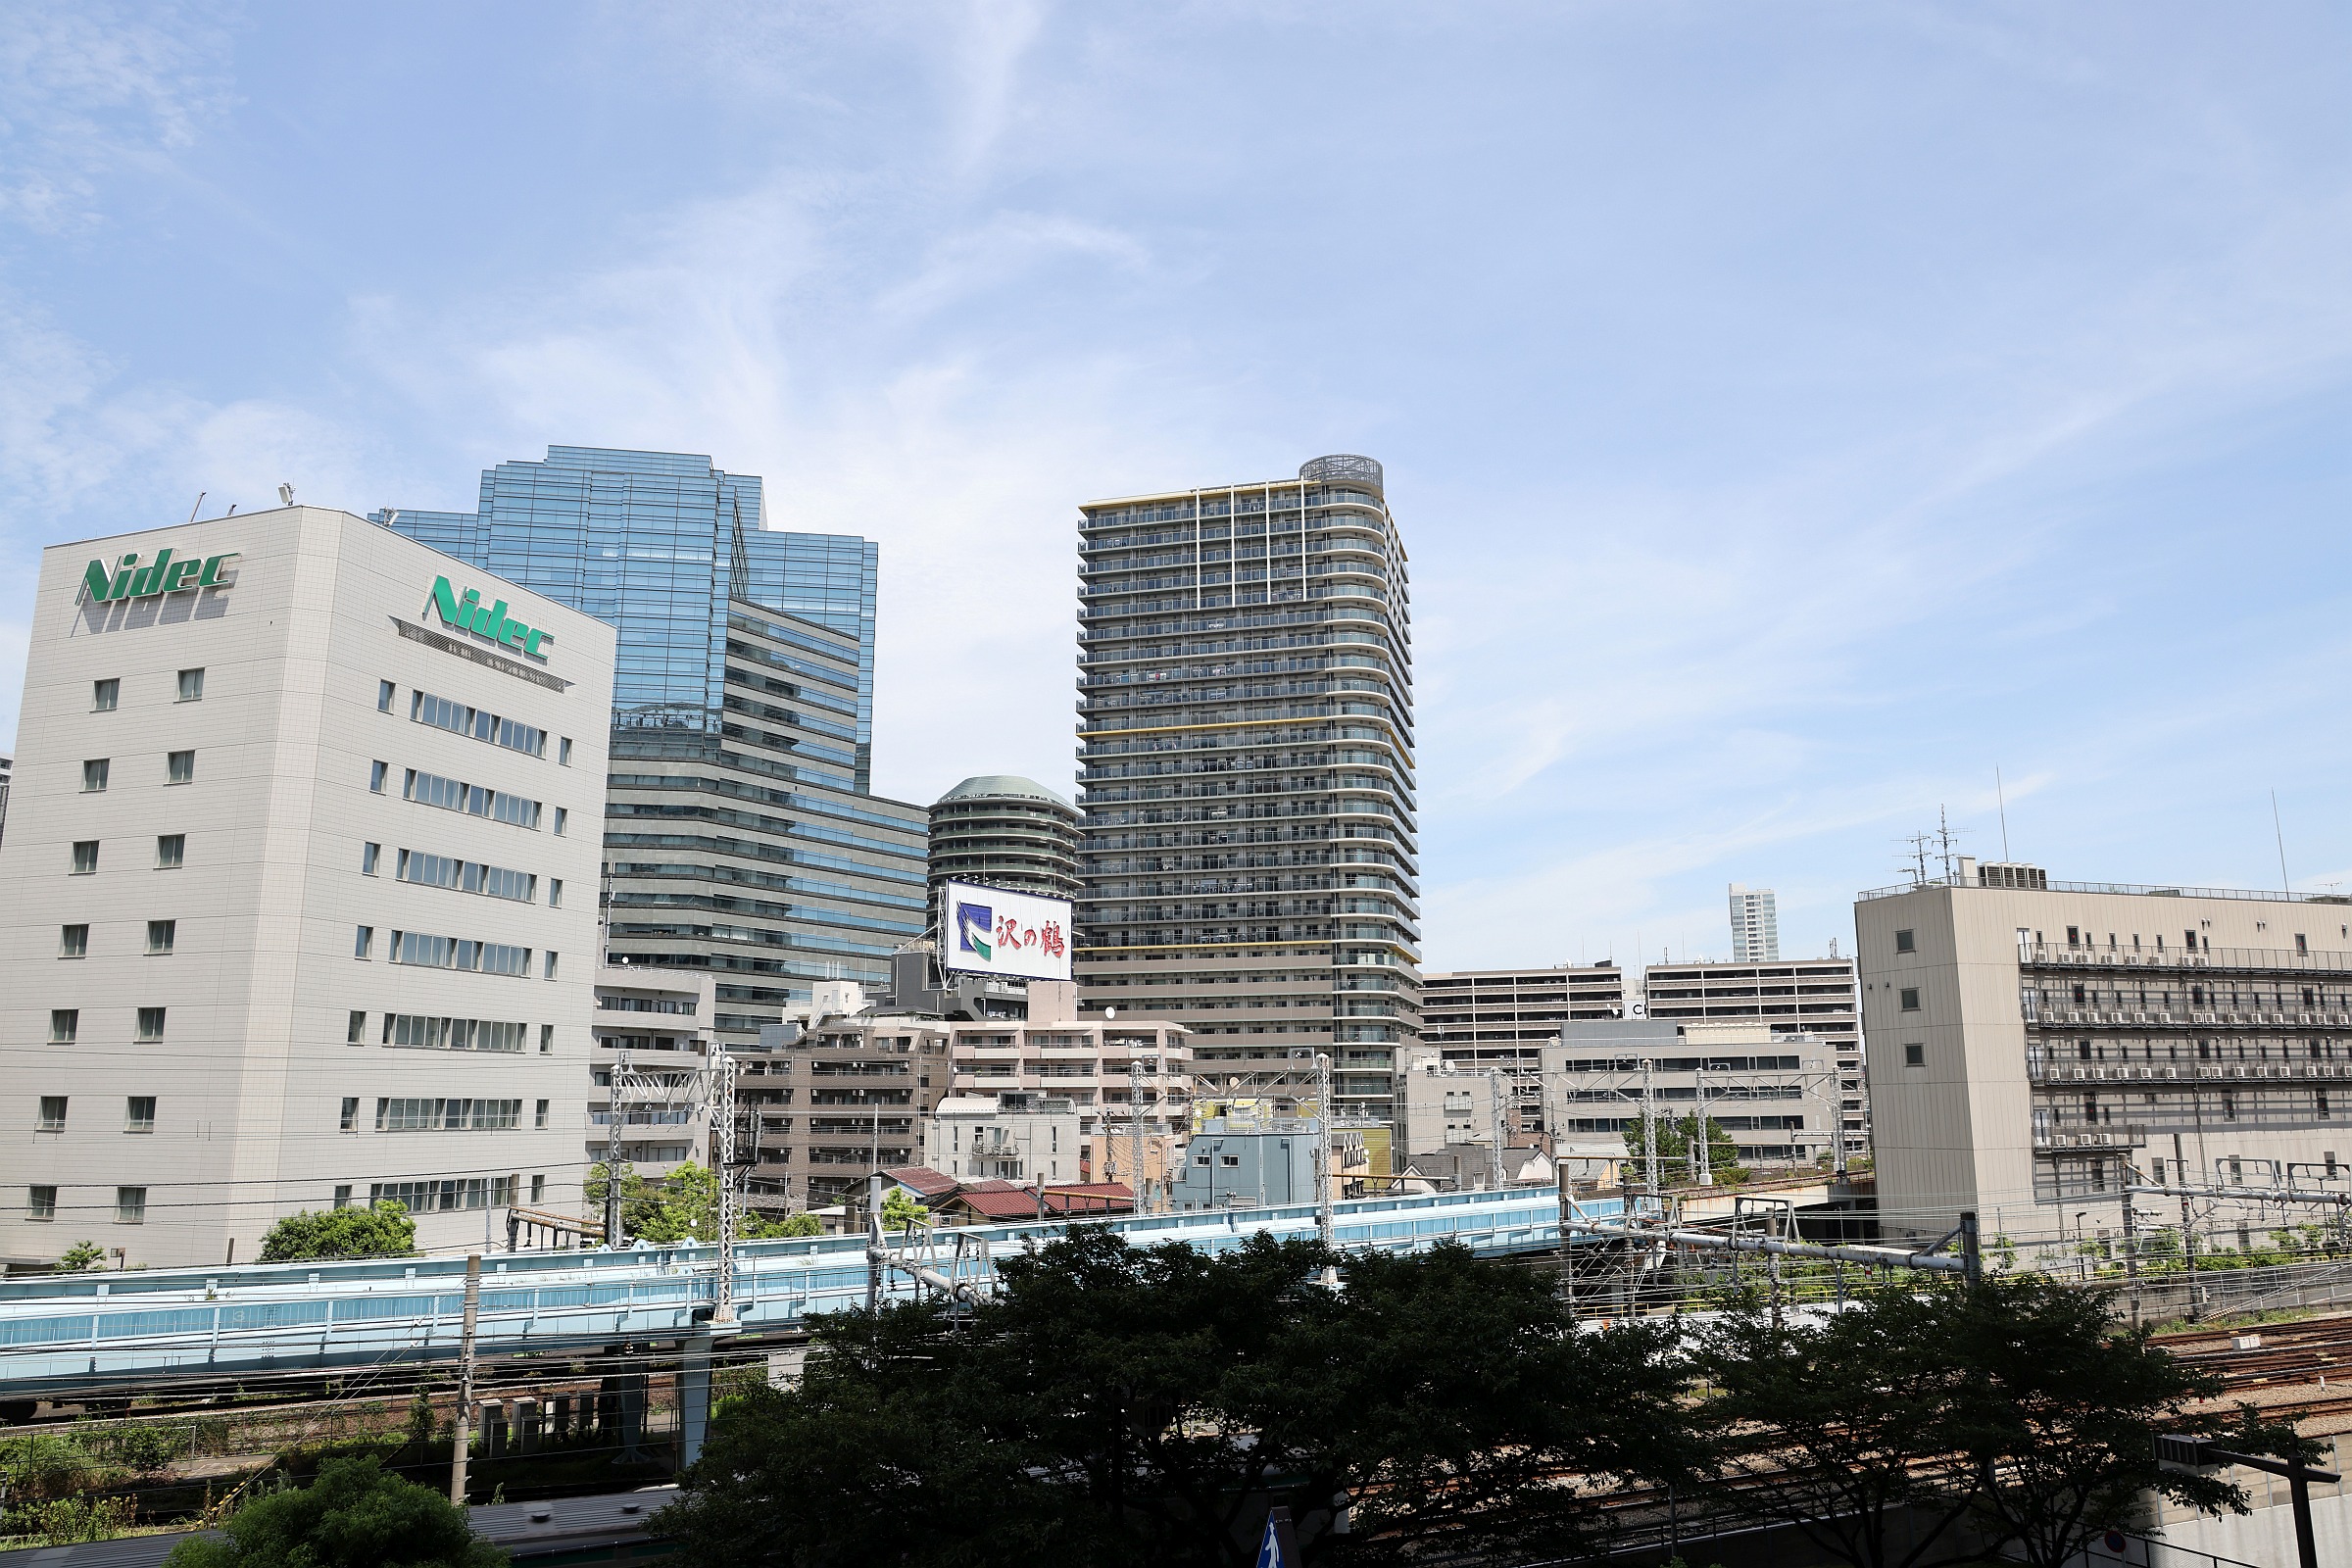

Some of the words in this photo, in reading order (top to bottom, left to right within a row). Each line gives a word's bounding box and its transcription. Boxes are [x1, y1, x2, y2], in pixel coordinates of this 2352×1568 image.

[74, 548, 241, 606] Nidec
[422, 574, 555, 661] Nidec
[996, 915, 1065, 958] 沢の鶴
